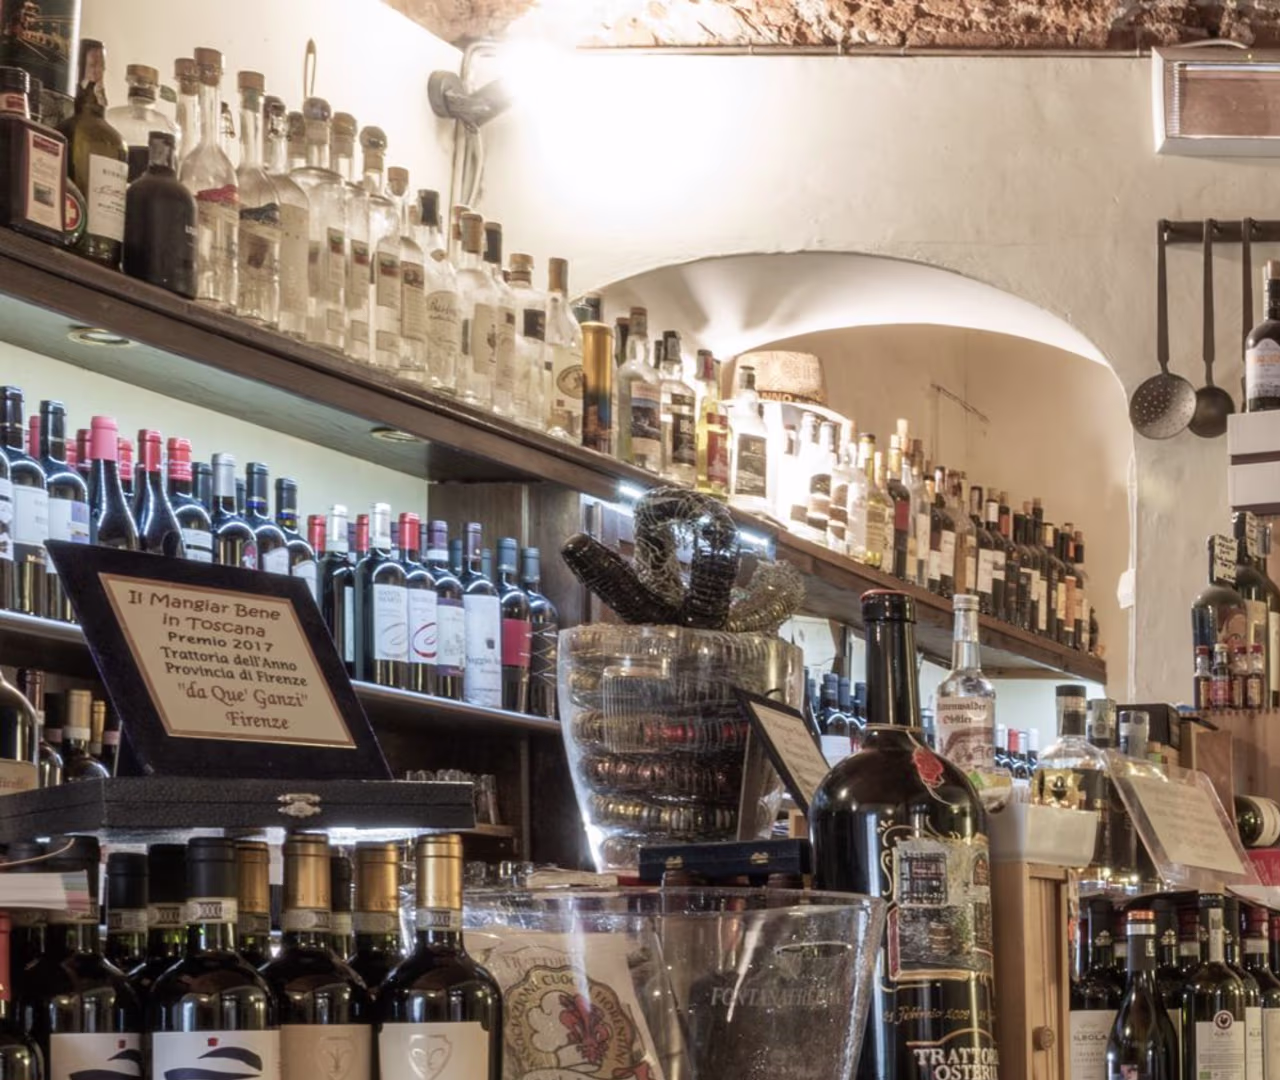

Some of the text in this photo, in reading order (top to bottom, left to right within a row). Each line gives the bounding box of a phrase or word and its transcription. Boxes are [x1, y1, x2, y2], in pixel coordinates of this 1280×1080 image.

[128, 590, 281, 621] Il Mangiar Bene
[163, 613, 266, 638] in Toscana
[168, 631, 275, 653] Premio 2017
[160, 646, 298, 672] Trattoria dell'Anno
[165, 662, 309, 687] Provincia di Firenze
[210, 686, 249, 705] Que'
[252, 689, 308, 710] Ganzi"
[225, 711, 290, 731] Firenze
